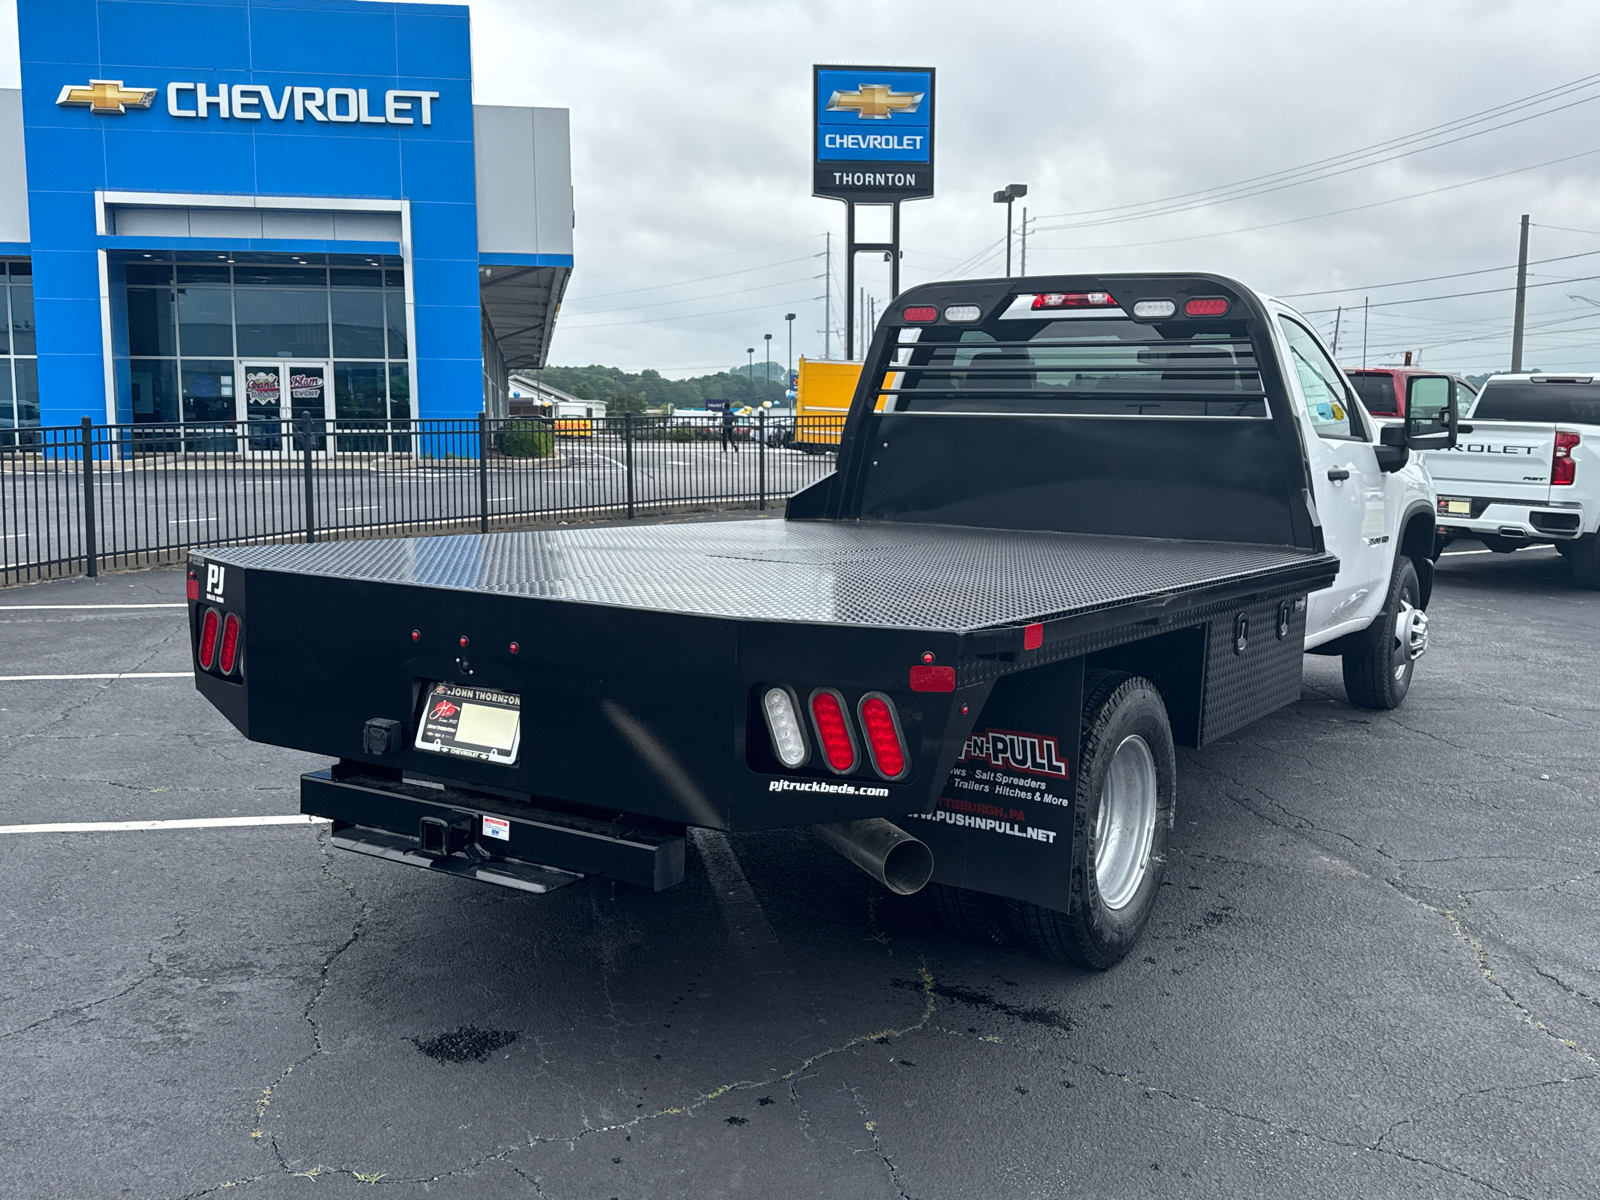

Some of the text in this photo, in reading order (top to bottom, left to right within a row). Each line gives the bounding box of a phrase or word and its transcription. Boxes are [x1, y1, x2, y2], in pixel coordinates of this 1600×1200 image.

[166, 81, 440, 126] CHEVROLET
[824, 134, 924, 150] CHEVROLET
[833, 172, 916, 186] THORNTON
[293, 390, 320, 398] EVENT
[1446, 443, 1538, 455] ROLET
[206, 563, 225, 595] PJ
[450, 687, 520, 705] JOHN THORNTON
[768, 779, 889, 797] pjtruckbeds.com
[975, 769, 995, 782] Salt
[995, 772, 1047, 790] Spreaders
[953, 778, 1069, 807] Trailers Hitches & More
[1009, 808, 1026, 822] PA
